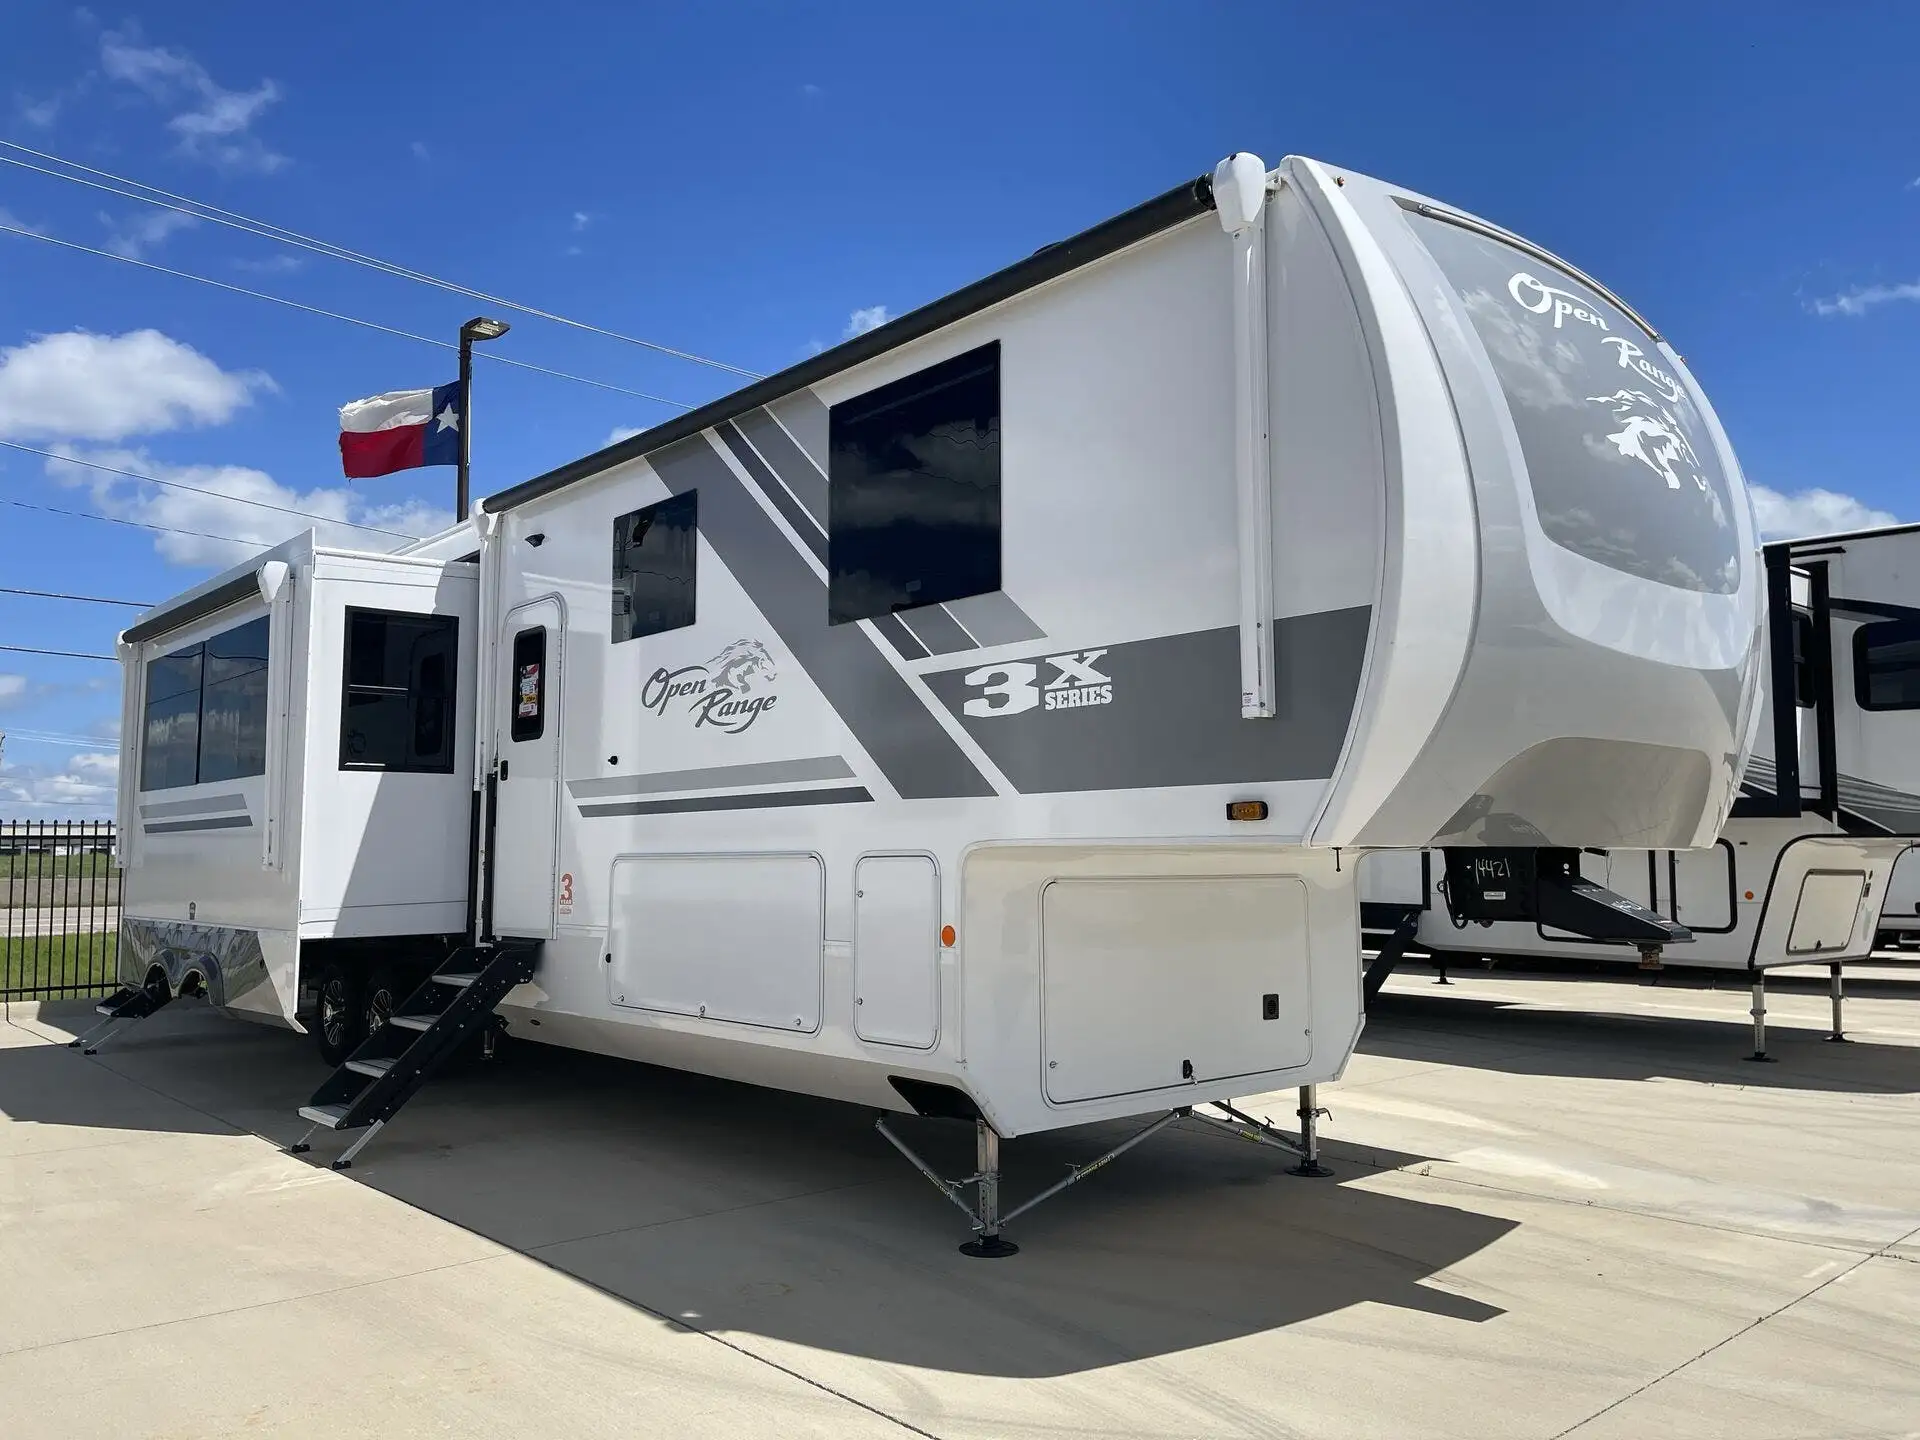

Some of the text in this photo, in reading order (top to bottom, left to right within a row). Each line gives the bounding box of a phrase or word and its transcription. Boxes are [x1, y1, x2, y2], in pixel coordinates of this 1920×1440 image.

[1508, 272, 1610, 331] Open
[1601, 337, 1687, 403] Range
[642, 665, 709, 717] Open
[688, 688, 778, 735] Range
[1044, 685, 1113, 711] SERIES
[560, 873, 573, 900] 3
[1475, 857, 1511, 885] 14421
